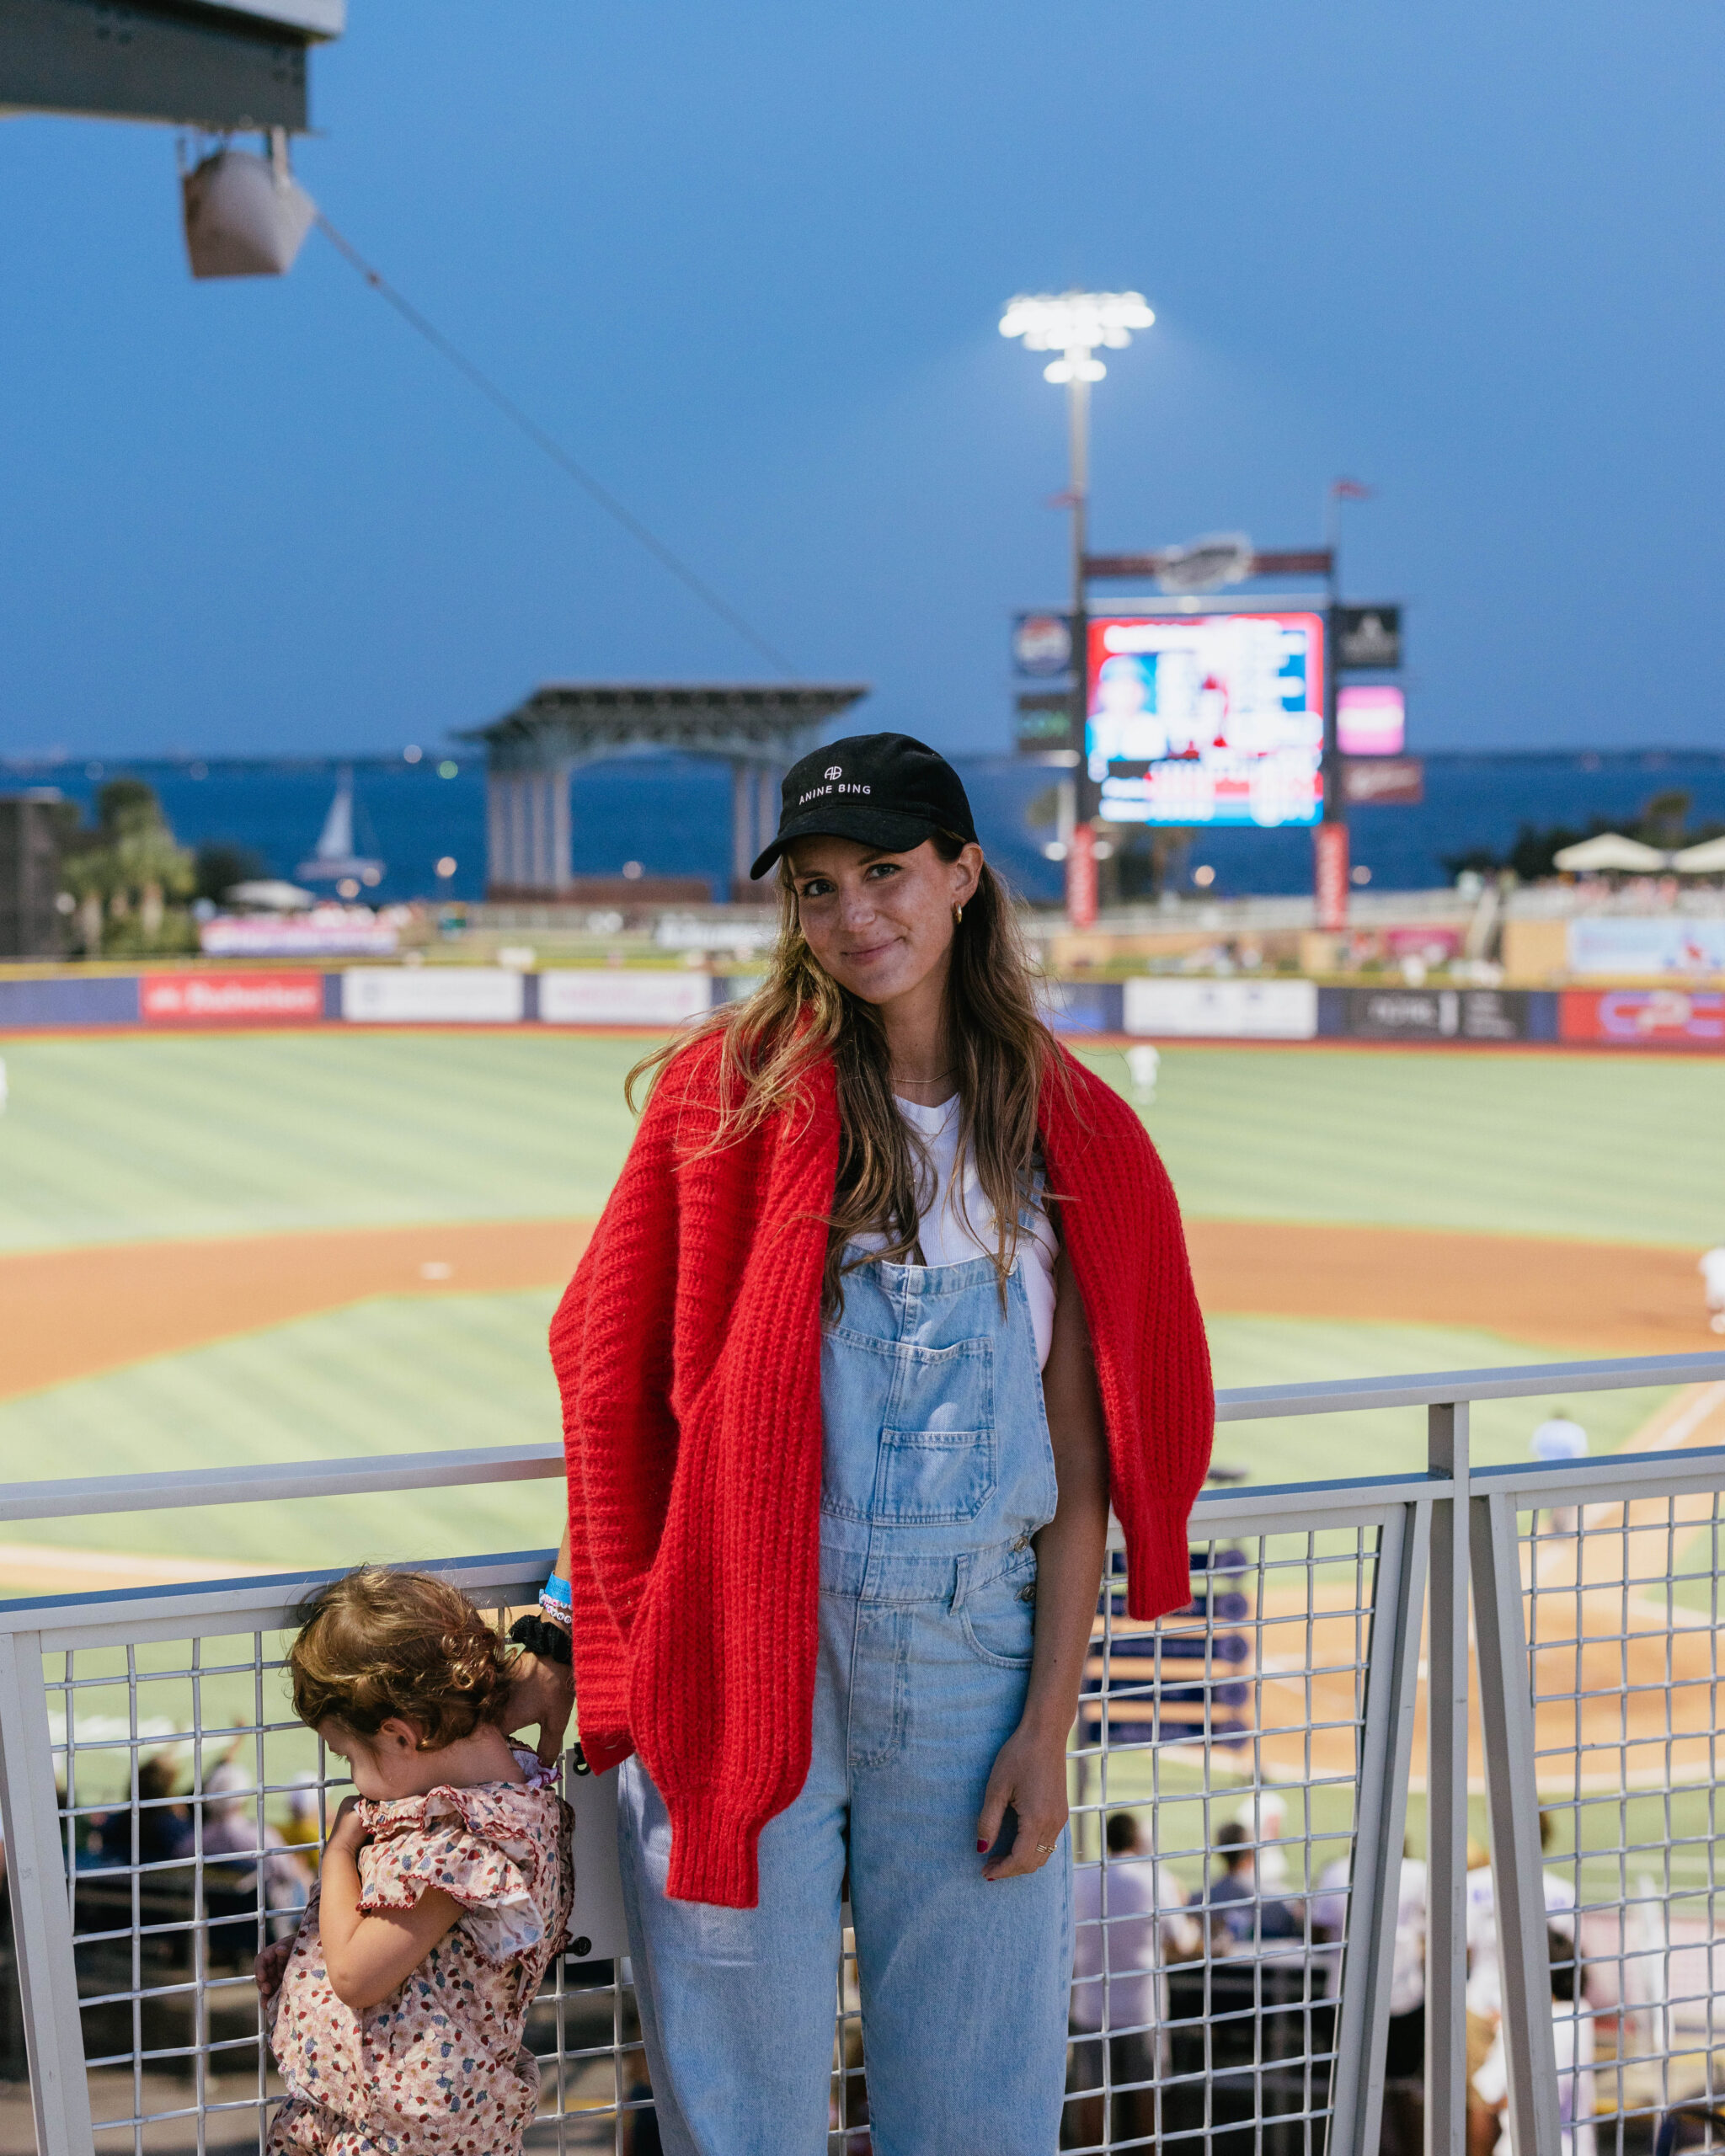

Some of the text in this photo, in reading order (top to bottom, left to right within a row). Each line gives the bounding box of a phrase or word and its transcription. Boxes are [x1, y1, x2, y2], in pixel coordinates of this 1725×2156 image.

[824, 766, 842, 781] AB
[798, 783, 871, 805] ANINE BING
